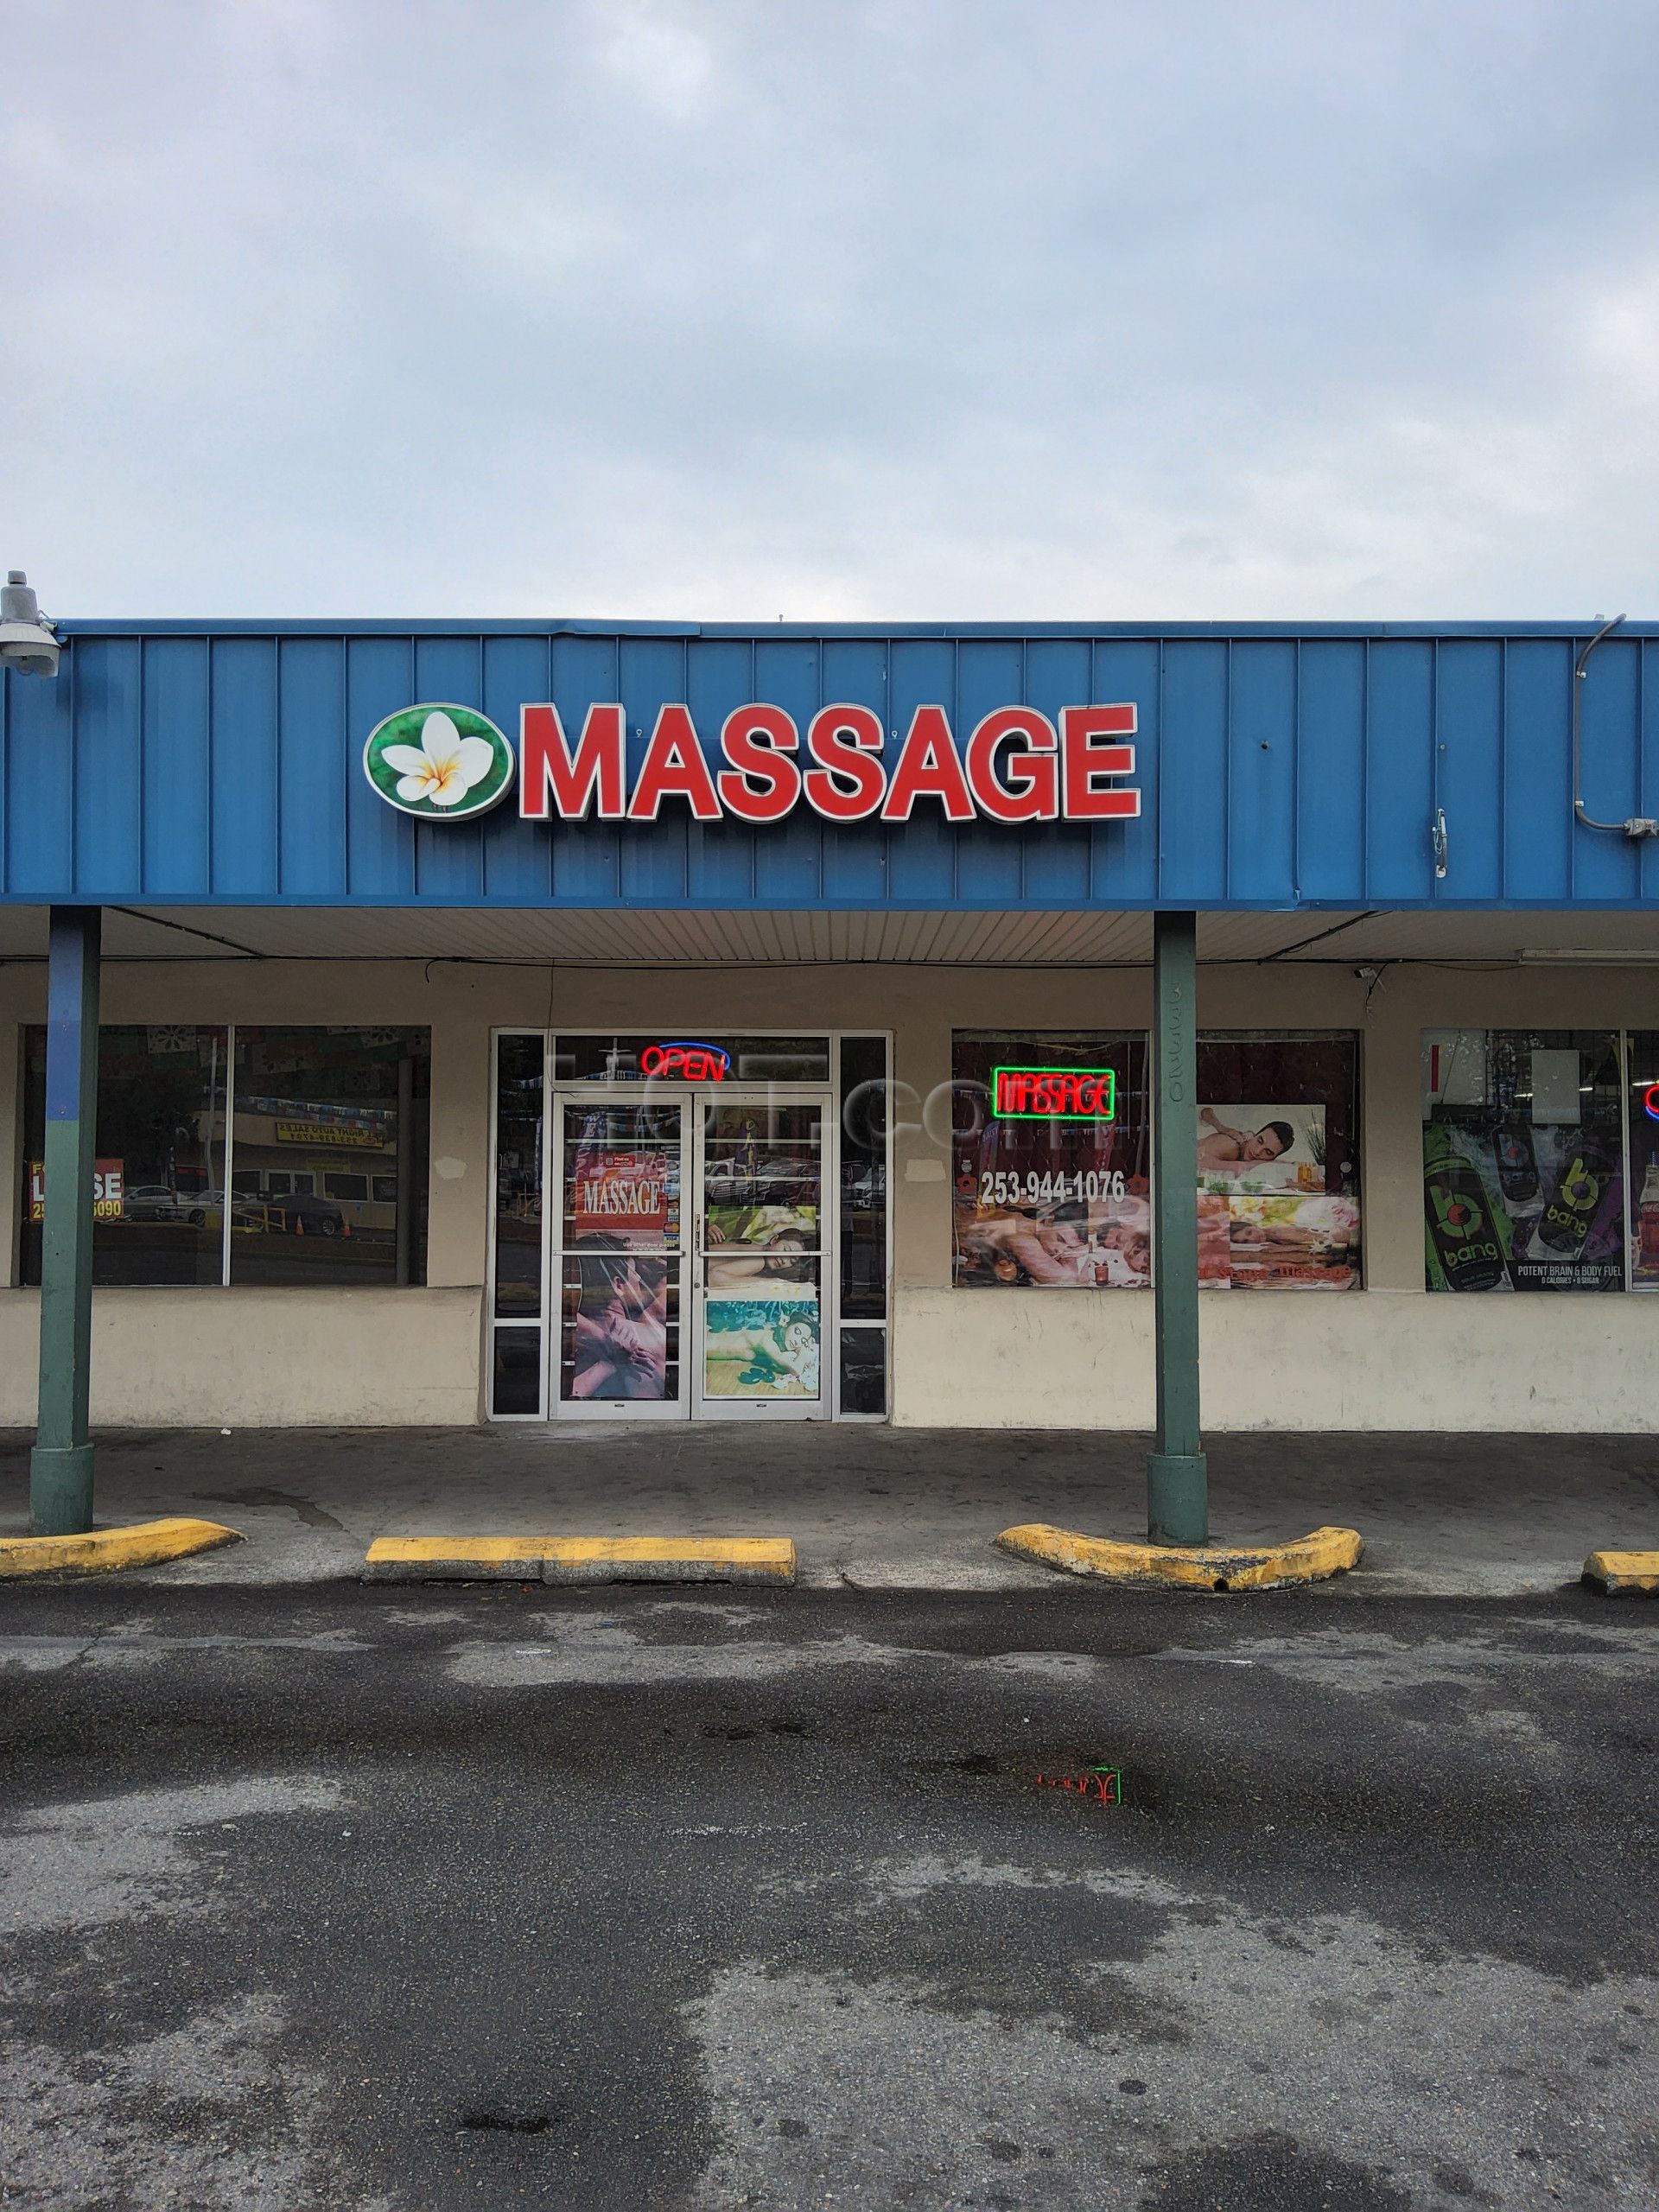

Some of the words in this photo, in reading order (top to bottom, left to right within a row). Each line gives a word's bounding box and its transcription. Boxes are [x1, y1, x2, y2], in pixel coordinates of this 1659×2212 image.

[518, 702, 1141, 824] MASSAGE
[641, 1046, 727, 1082] OPEN
[997, 1073, 1111, 1115] MASSAGE
[33, 1173, 123, 1201] LSE
[582, 1179, 661, 1215] MASSAGE
[982, 1170, 1125, 1205] 253-944-1076
[1547, 1205, 1589, 1238] bang
[1444, 1243, 1498, 1267] bang
[1518, 1265, 1548, 1276] POTENT
[1549, 1265, 1573, 1276] BRAIN
[1574, 1266, 1580, 1276] &
[1582, 1265, 1602, 1276] BODY
[1604, 1266, 1623, 1276] FUEL
